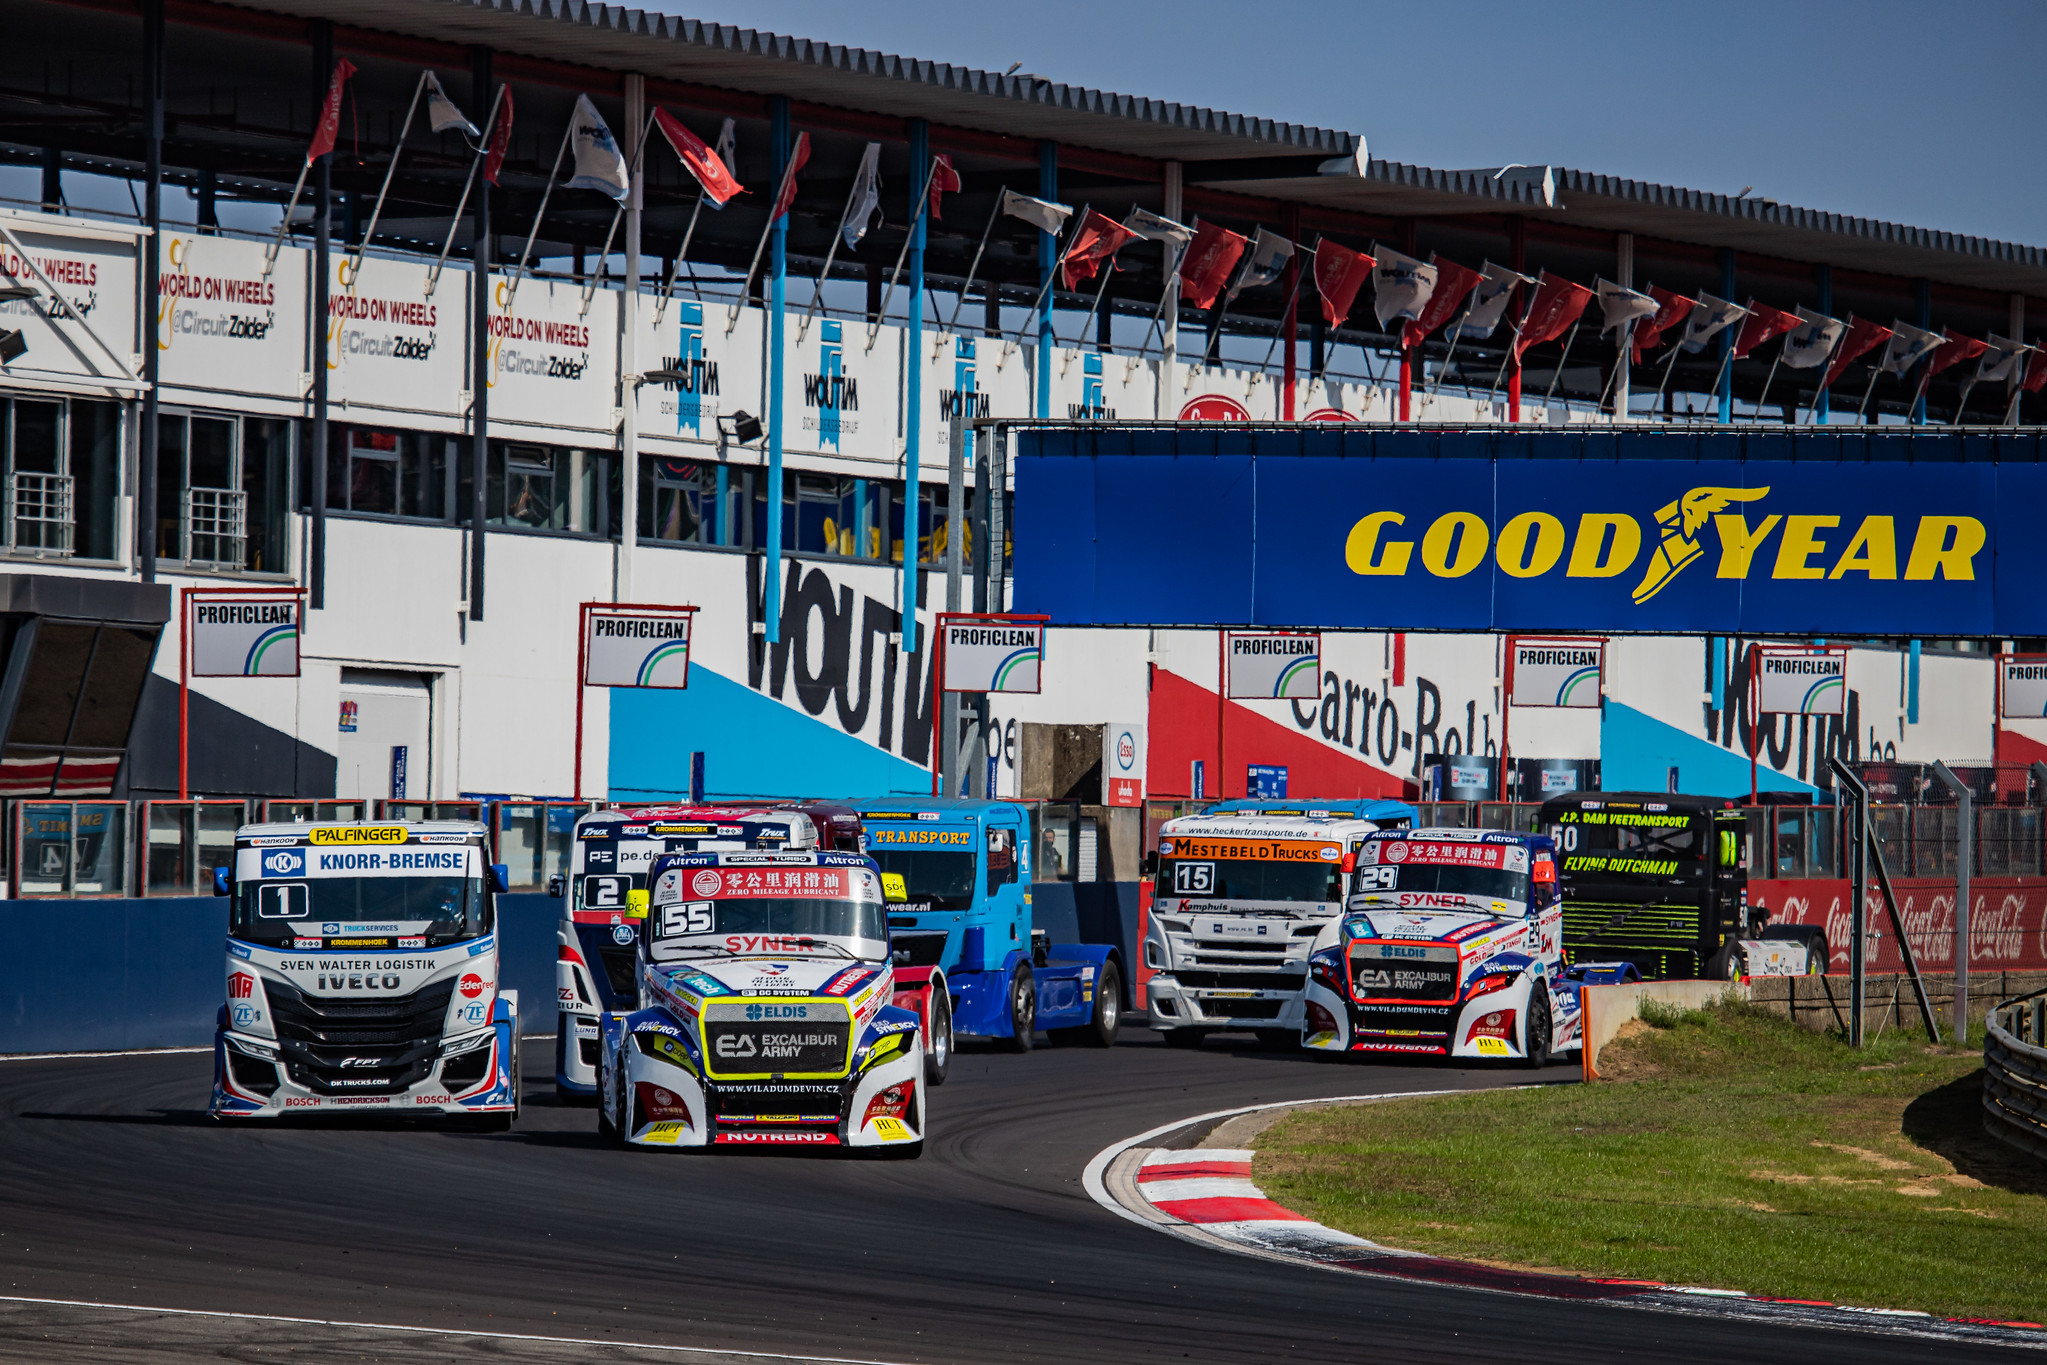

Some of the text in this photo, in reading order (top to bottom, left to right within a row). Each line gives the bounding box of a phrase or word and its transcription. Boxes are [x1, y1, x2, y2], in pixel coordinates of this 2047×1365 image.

[44, 258, 97, 287] WHEELS
[159, 272, 274, 306] WORLD ON WHEELS
[328, 294, 437, 328] WORLD ON WHEELS
[487, 314, 589, 349] WORLD ON WHEELS
[198, 605, 292, 625] PROFICLEAN
[595, 619, 684, 639] PROFICLEAN
[951, 628, 1035, 647] PROFICLEAN
[1234, 639, 1314, 655] PROFICLEAN
[1519, 650, 1597, 667] PROFICLEAN
[1766, 659, 1840, 675] PROFICLEAN
[1560, 811, 1690, 828] J.P. DAM VEETRANSPORT
[316, 828, 402, 842] PALFINGER
[876, 831, 970, 845] TRANSPORT
[1188, 827, 1308, 838] www.heckertransporte.de
[1371, 831, 1402, 839] Altron
[1486, 834, 1518, 843] Altron
[1551, 824, 1578, 852] 50
[320, 853, 463, 870] KNORR-BREMSE
[667, 856, 707, 866] Altron
[825, 856, 865, 865] Altron
[1564, 856, 1679, 875] FLYING DUTCHMAN
[726, 871, 840, 888] 零公里润滑油
[1179, 866, 1210, 890] 15
[1361, 867, 1396, 890] 29
[597, 878, 619, 905] 2
[753, 888, 790, 896] MILEAGE
[793, 888, 840, 896] LUBRICANT
[276, 887, 290, 914] 1
[1178, 899, 1228, 912] Kamphuis
[664, 904, 712, 934] 55
[330, 938, 388, 947] KROMMENHOEK
[726, 936, 815, 953] SYNER
[1394, 947, 1426, 958] ELDIS
[280, 959, 436, 971] SVEN WALTER LOGISTIK
[318, 973, 400, 990] IVECO
[828, 968, 868, 994] NUTREND
[1394, 971, 1451, 983] EXCALIBUR
[459, 979, 494, 992] Edenred
[1394, 981, 1425, 990] ARMY
[764, 1005, 807, 1018] ELDIS
[1357, 1005, 1449, 1015] WWW.VILADUMDEVIN.CZ
[761, 1034, 838, 1046] EXCALIBUR
[761, 1046, 802, 1058] ARMY
[1362, 1043, 1440, 1052] NUTREND
[717, 1085, 840, 1093] WWW.VILADUMDEVIN.CZ
[285, 1097, 321, 1107] BOSCH
[416, 1095, 451, 1105] BOSCH
[727, 1133, 828, 1141] NUTREND
